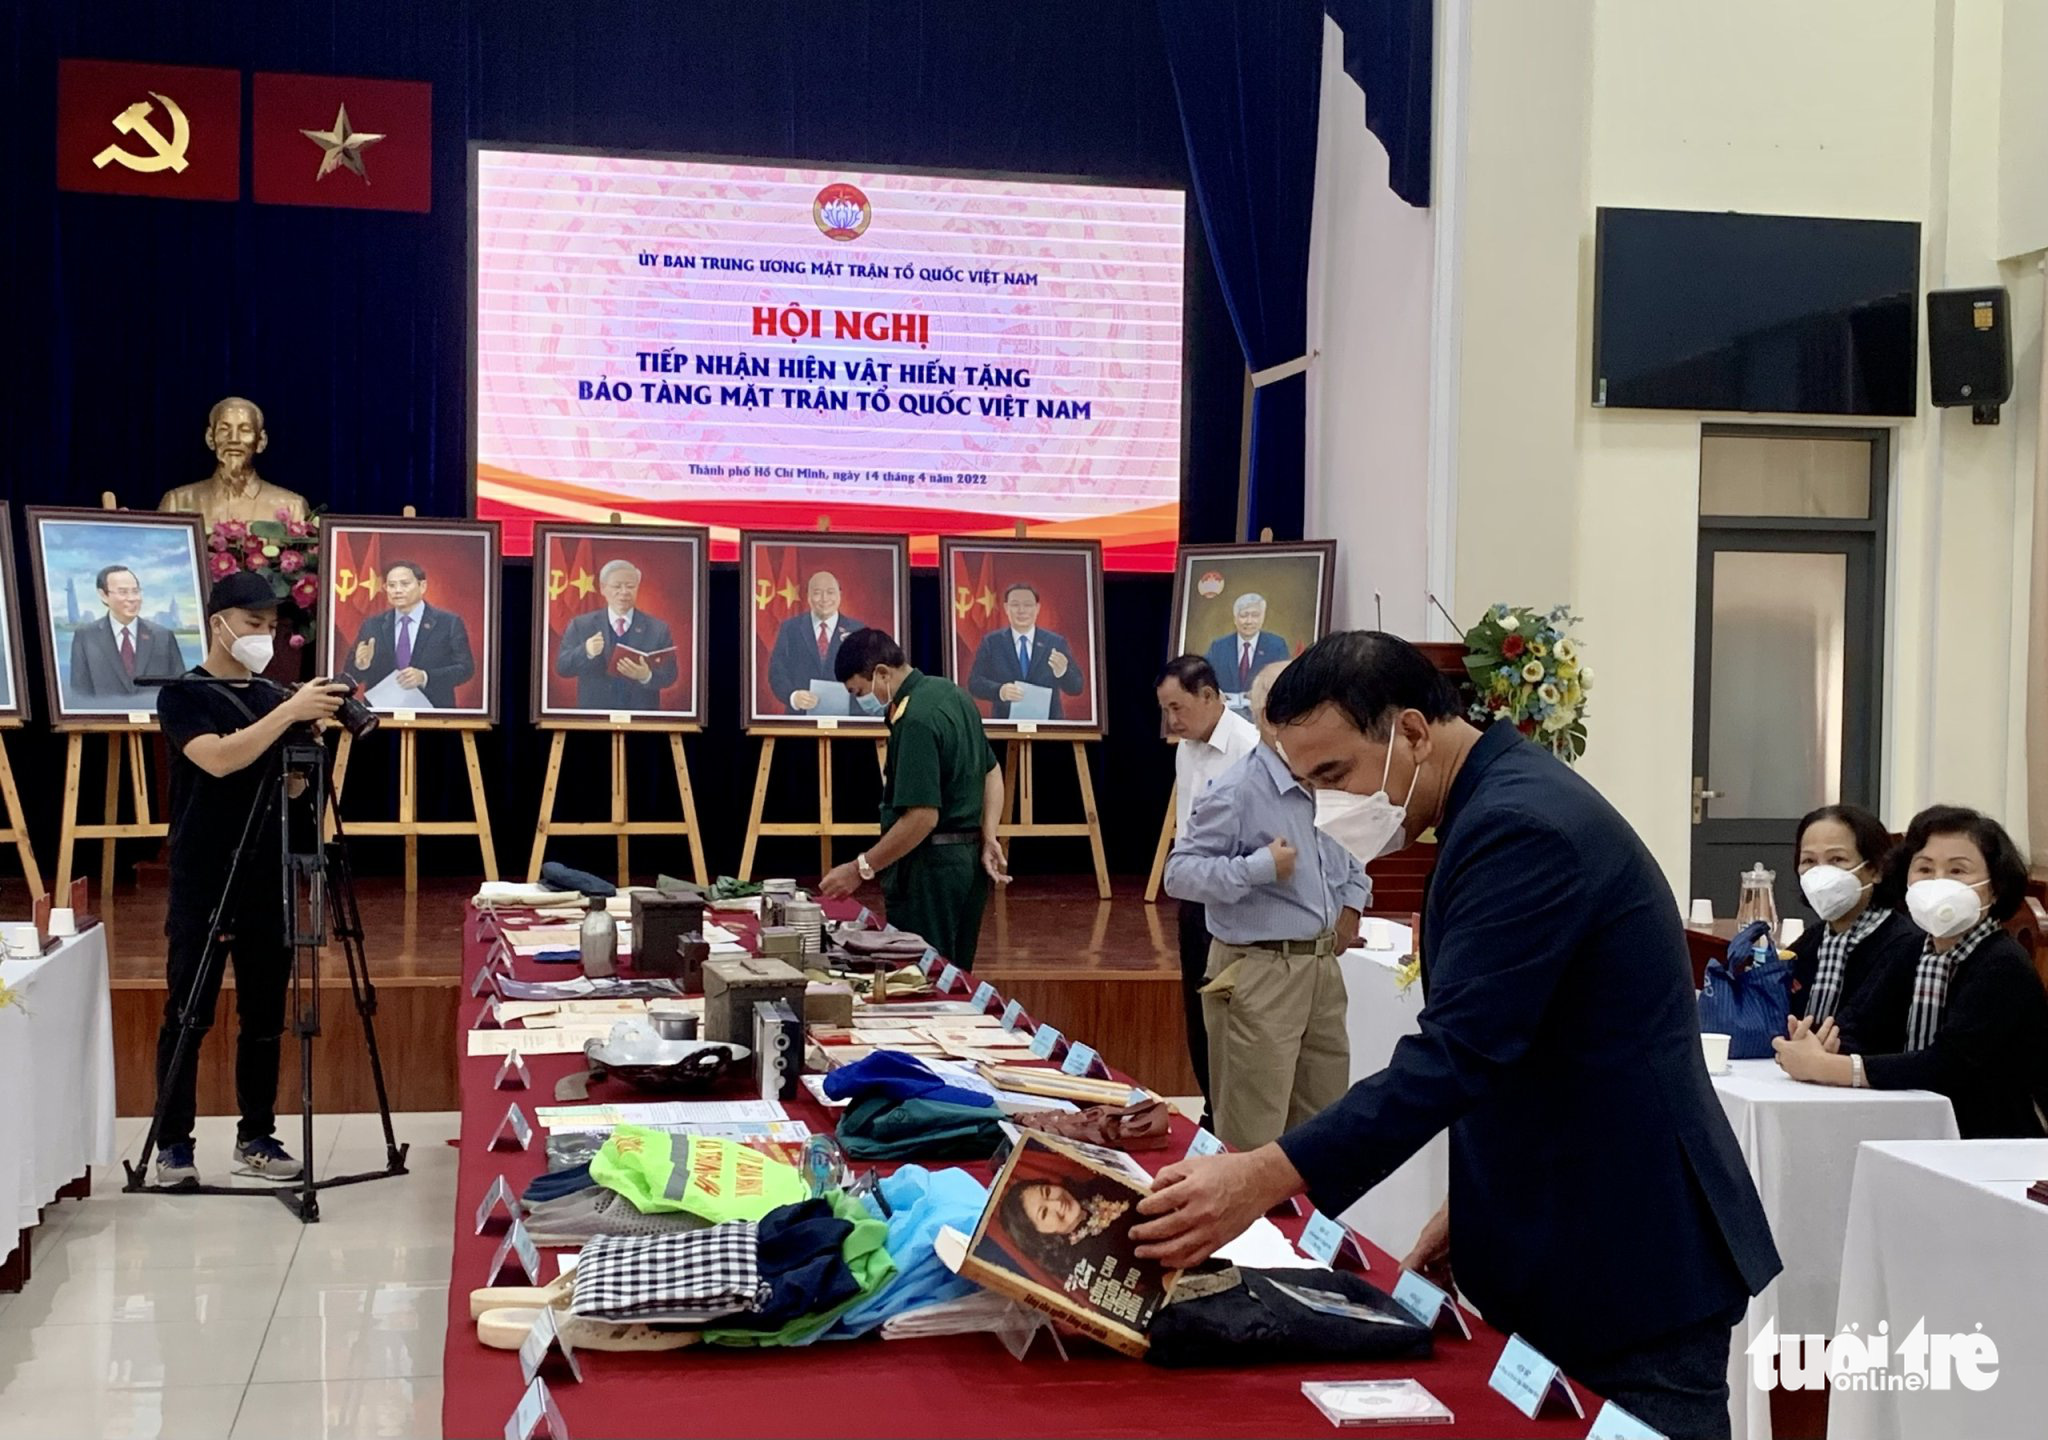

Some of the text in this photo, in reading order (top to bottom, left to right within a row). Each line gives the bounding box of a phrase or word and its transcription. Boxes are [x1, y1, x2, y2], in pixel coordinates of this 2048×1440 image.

[638, 249, 1038, 286] ỦY BAN TRUNG ƯƠNG MẶT TRẬN TỔ QUỐC VIỆT NAM
[752, 302, 929, 350] HỘI NGHỊ
[636, 347, 1031, 391] TIẾP NHẬN HIỆN VẬT HIẾN TẶNG
[578, 374, 1092, 421] BẢO TÀNG MẶT TRẬN TỔ QUỐC VIỆT NAM
[688, 463, 724, 476] Thành
[728, 465, 751, 478] phố
[774, 466, 794, 478] Chí
[797, 467, 829, 480] Minh,
[832, 470, 861, 482] ngày
[865, 471, 879, 481] 14
[883, 471, 915, 484] tháng
[918, 472, 926, 482] 4
[929, 473, 953, 484] năm
[957, 473, 987, 484] 2022
